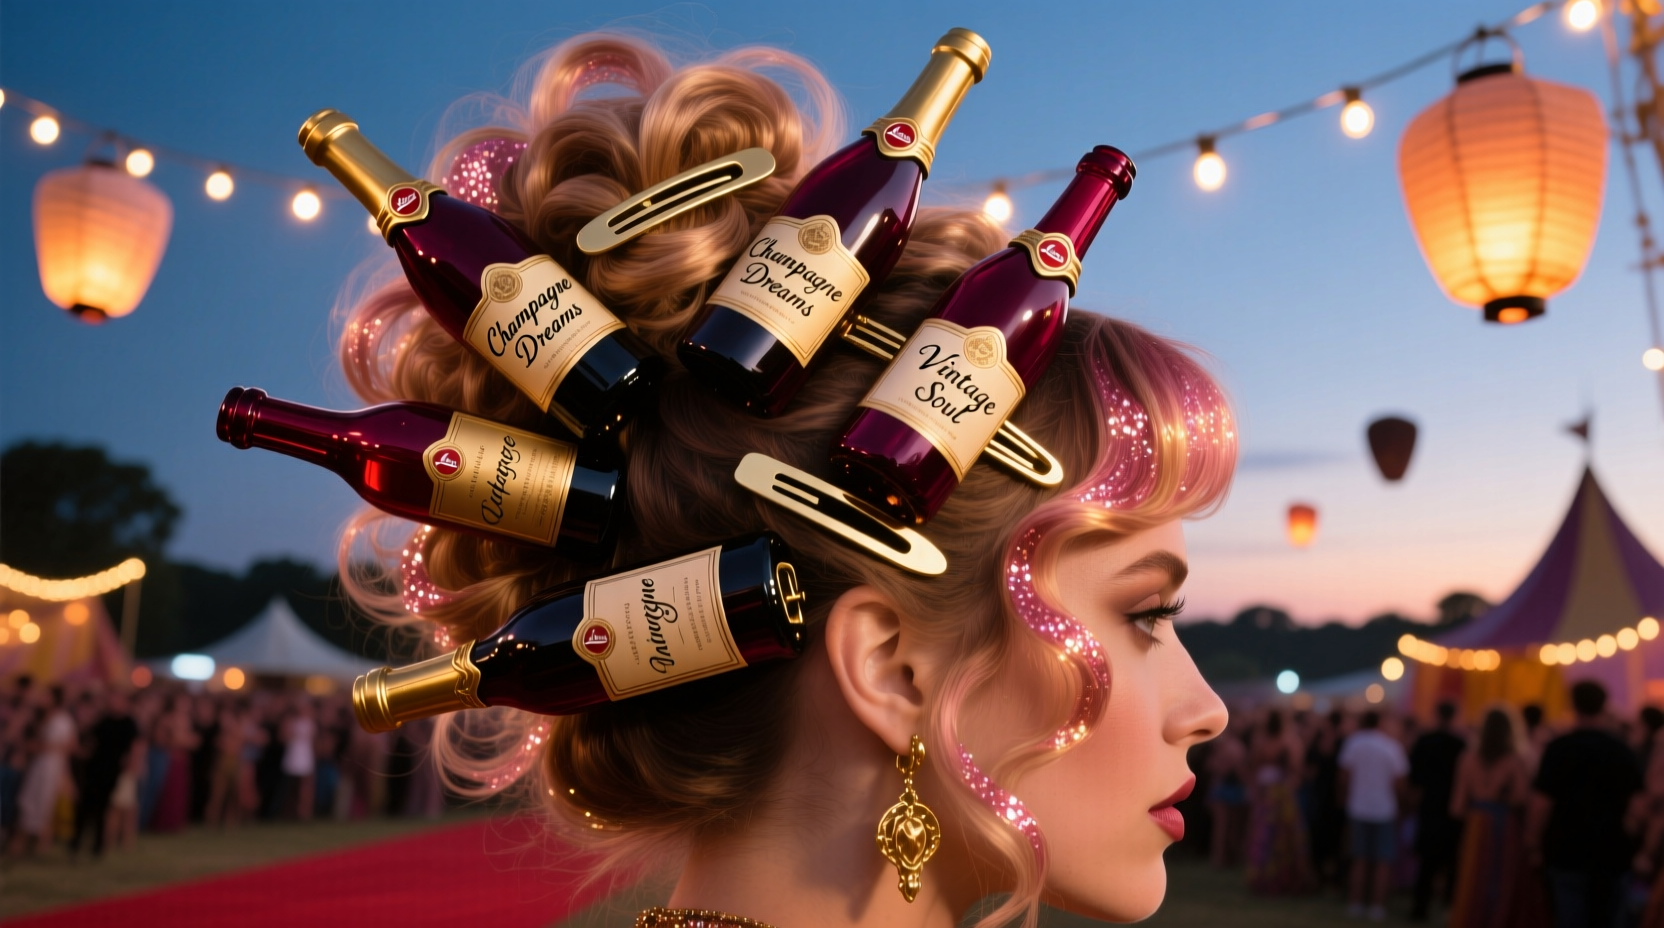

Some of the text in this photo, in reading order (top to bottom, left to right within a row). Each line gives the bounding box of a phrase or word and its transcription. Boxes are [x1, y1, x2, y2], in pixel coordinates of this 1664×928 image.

[740, 262, 815, 317] Dreams
[749, 237, 843, 302] Champagne
[487, 278, 572, 357] Champagne
[515, 303, 583, 368] Dreams
[914, 381, 972, 424] Soul
[919, 344, 996, 415] Vintage
